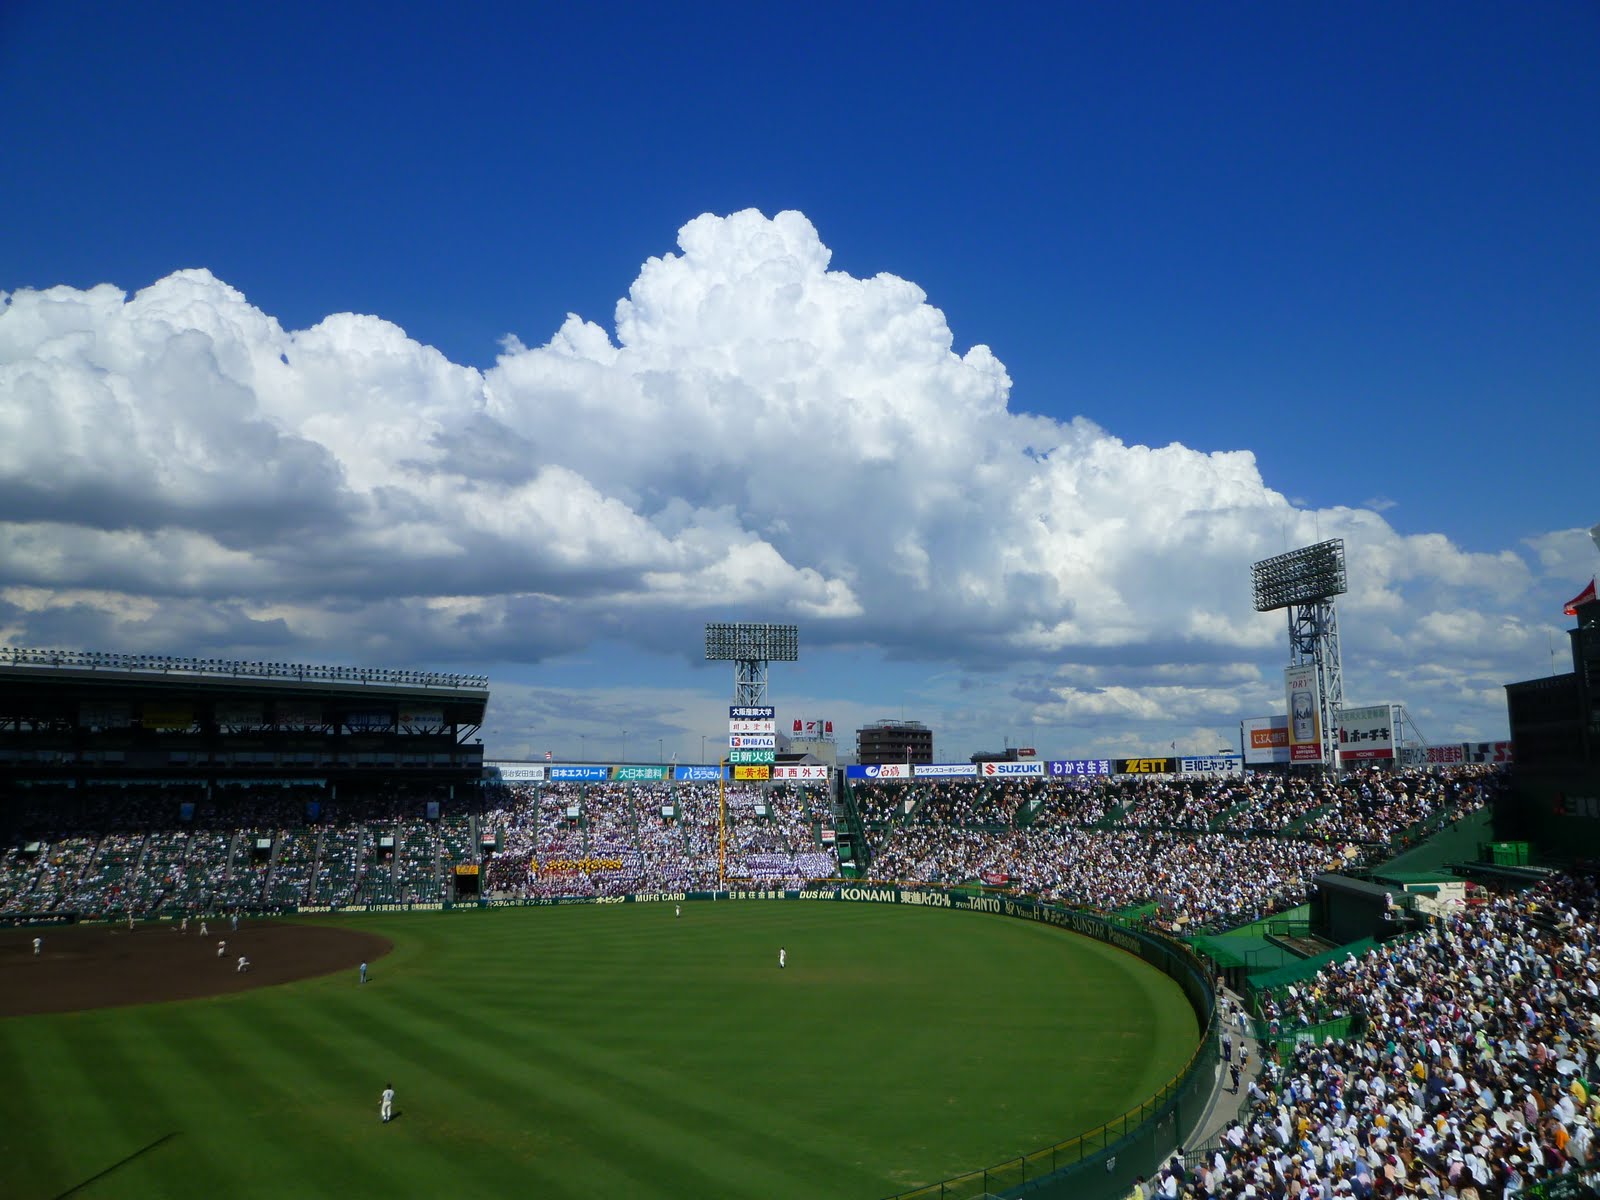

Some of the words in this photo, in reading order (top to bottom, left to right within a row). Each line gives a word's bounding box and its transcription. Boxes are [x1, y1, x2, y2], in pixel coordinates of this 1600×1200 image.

[732, 708, 772, 716] 大阪産業大学
[1350, 728, 1390, 743] ホーチキ
[743, 738, 774, 746] 伊藤ハム
[730, 751, 775, 762] 日新火災
[880, 766, 900, 777] 白鶴
[998, 764, 1042, 774] SUZUKI
[1053, 760, 1109, 774] わかさ生活
[1125, 759, 1167, 773] ZETT
[1185, 760, 1239, 772] 三和シャッター
[500, 770, 543, 778] 明治安田生命
[551, 768, 606, 778] 日本エスリード
[619, 768, 662, 780] 大日本塗料
[694, 770, 722, 779] ろうきん
[745, 768, 770, 778] 黄桜
[774, 767, 826, 778] 関西外大
[635, 894, 660, 903] MUFG
[662, 892, 686, 902] CARD
[799, 889, 835, 900] DUSKIN
[841, 888, 896, 903] KONAMI
[900, 890, 951, 908] 東進ハイスクール
[370, 903, 409, 912] UR賃貸住宅
[968, 896, 1001, 913] TANTO
[1072, 915, 1106, 938] SUNSTAR
